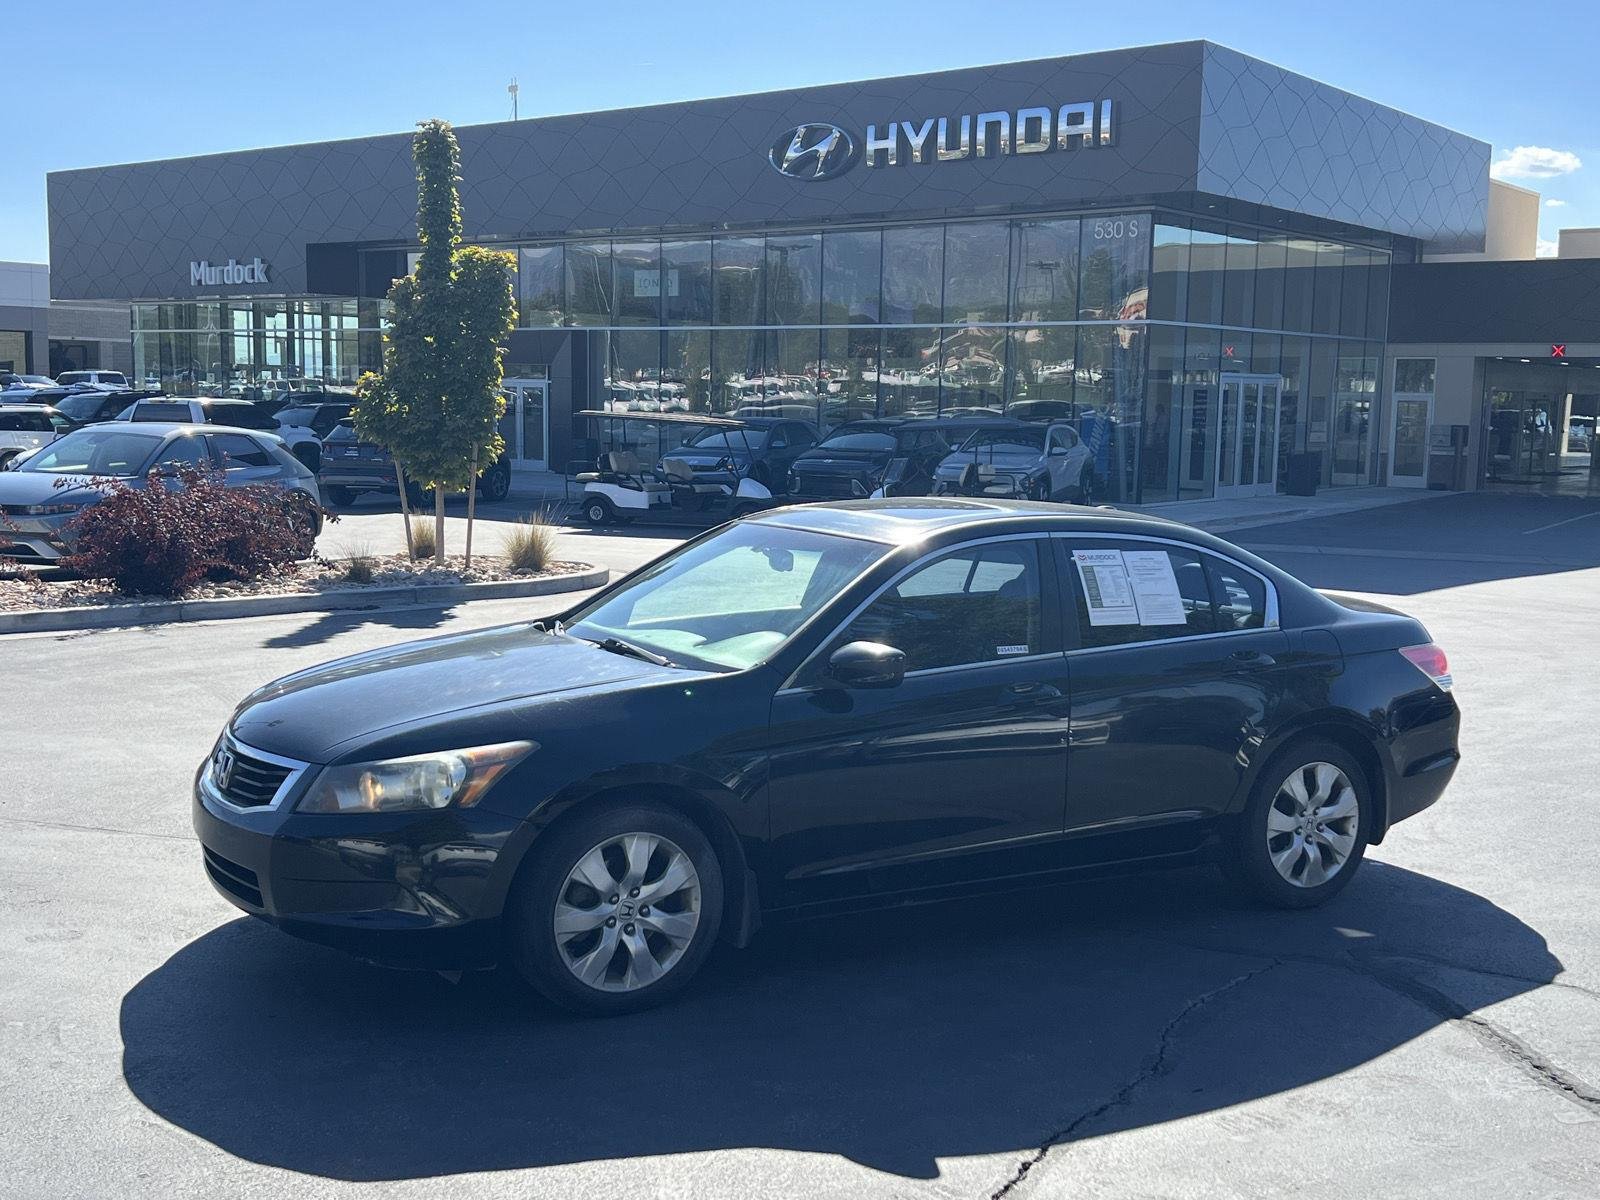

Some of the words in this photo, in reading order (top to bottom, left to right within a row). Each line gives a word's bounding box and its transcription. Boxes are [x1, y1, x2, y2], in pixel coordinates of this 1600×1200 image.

[865, 98, 1114, 168] HYUNDAI
[1094, 221, 1124, 239] 530
[1128, 219, 1138, 238] S
[190, 257, 269, 286] Murdock
[639, 278, 673, 289] IONQ
